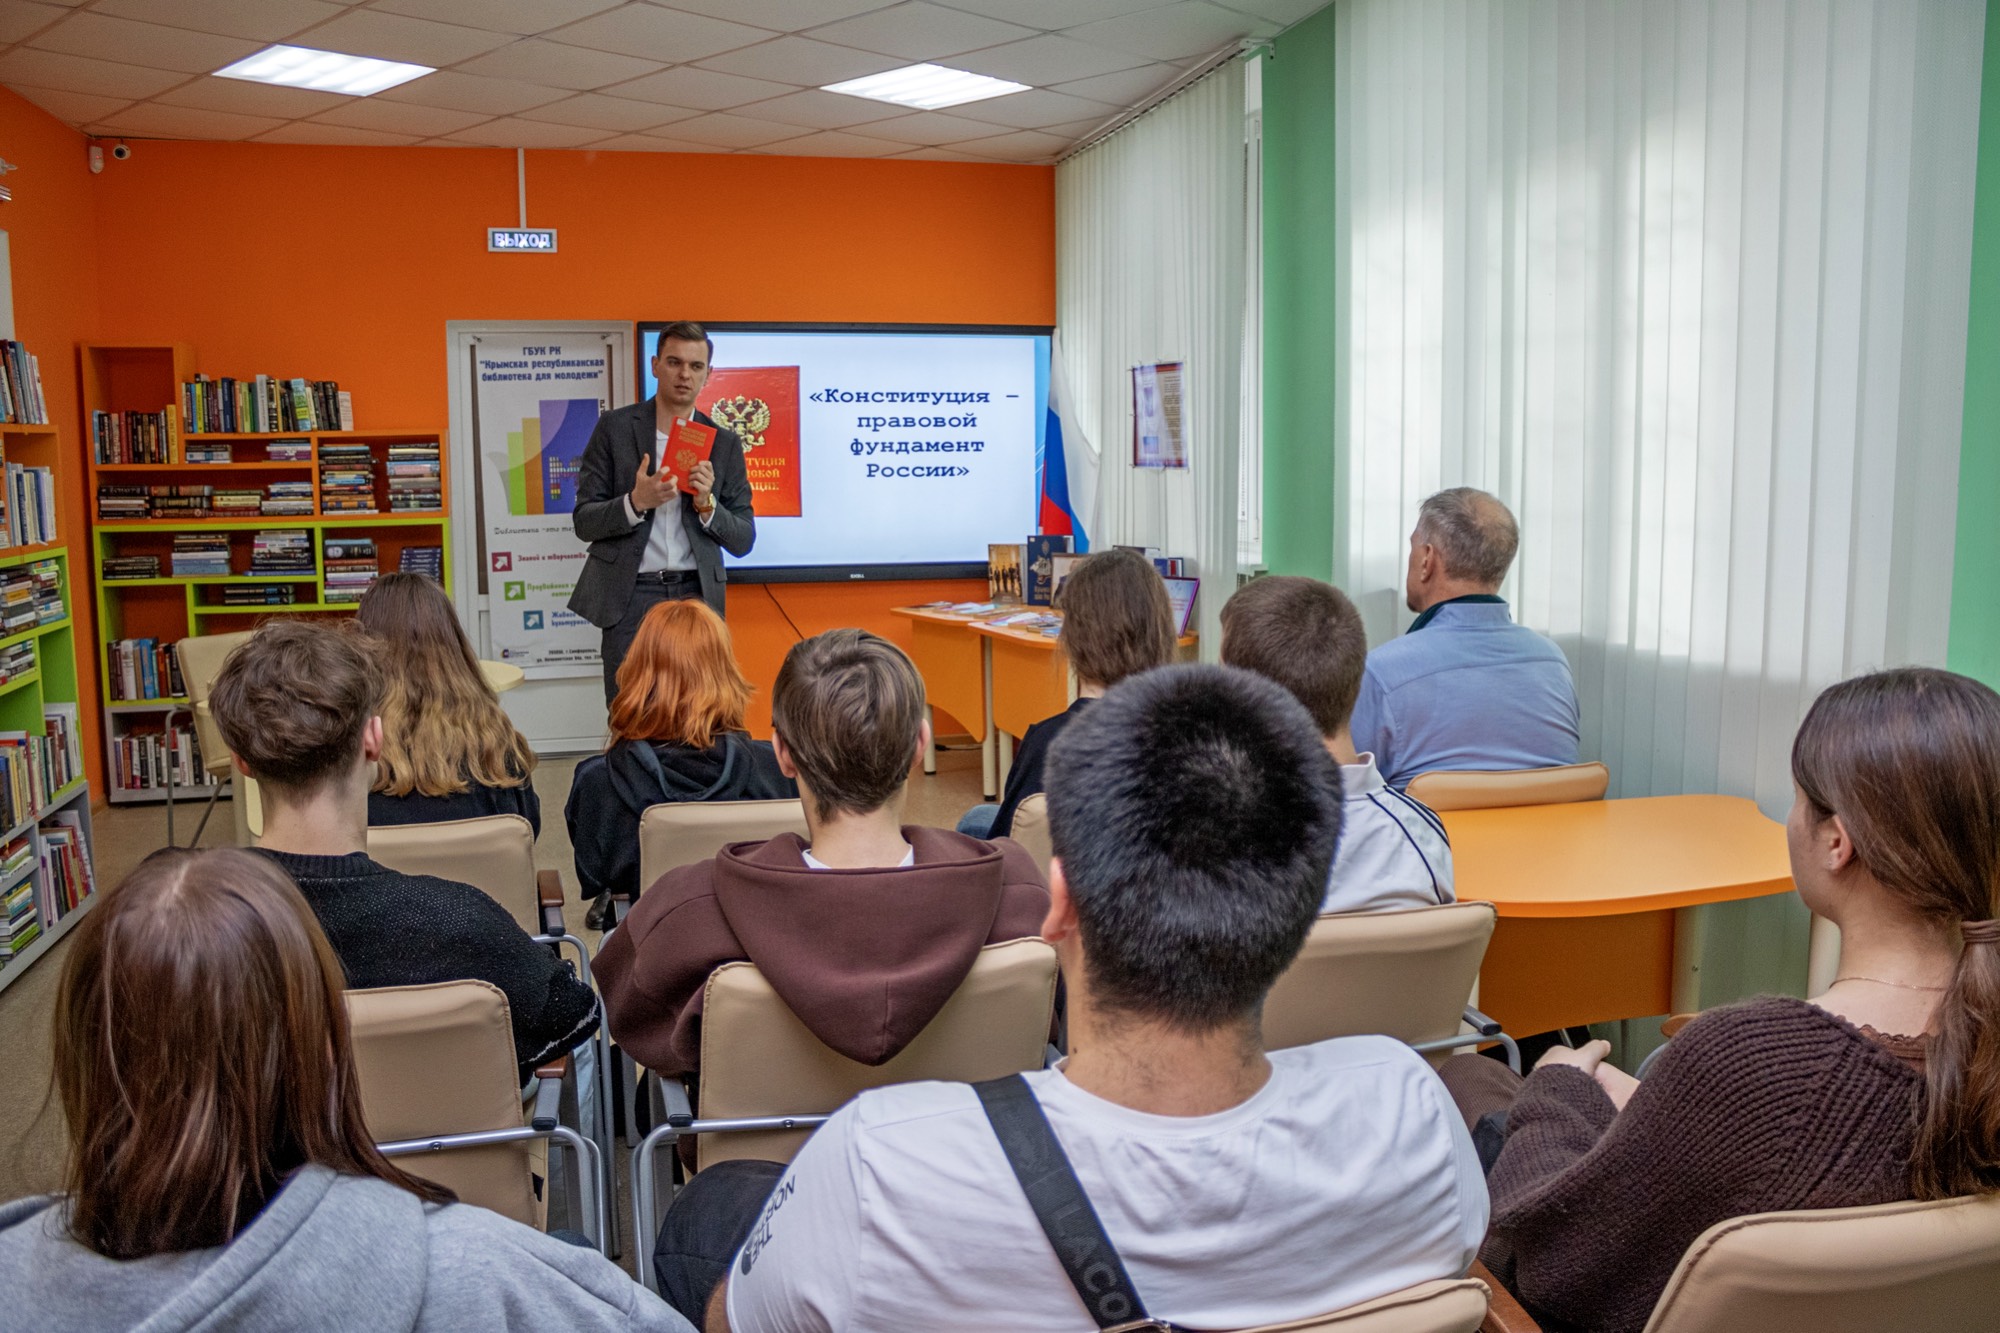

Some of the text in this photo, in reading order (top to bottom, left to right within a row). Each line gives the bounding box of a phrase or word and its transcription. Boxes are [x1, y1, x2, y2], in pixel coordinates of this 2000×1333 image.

[494, 233, 551, 248] ВЫХОД
[522, 346, 562, 356] ГБУК РК
[531, 358, 605, 370] республиканская
[482, 372, 532, 382] библиотека
[535, 373, 552, 382] для
[809, 388, 990, 405] «Конституция
[857, 412, 978, 432] правовой
[850, 438, 985, 456] фундамент
[746, 457, 786, 468] ТУЦИЯ
[866, 463, 970, 478] России»
[1051, 1202, 1132, 1320] LACO
